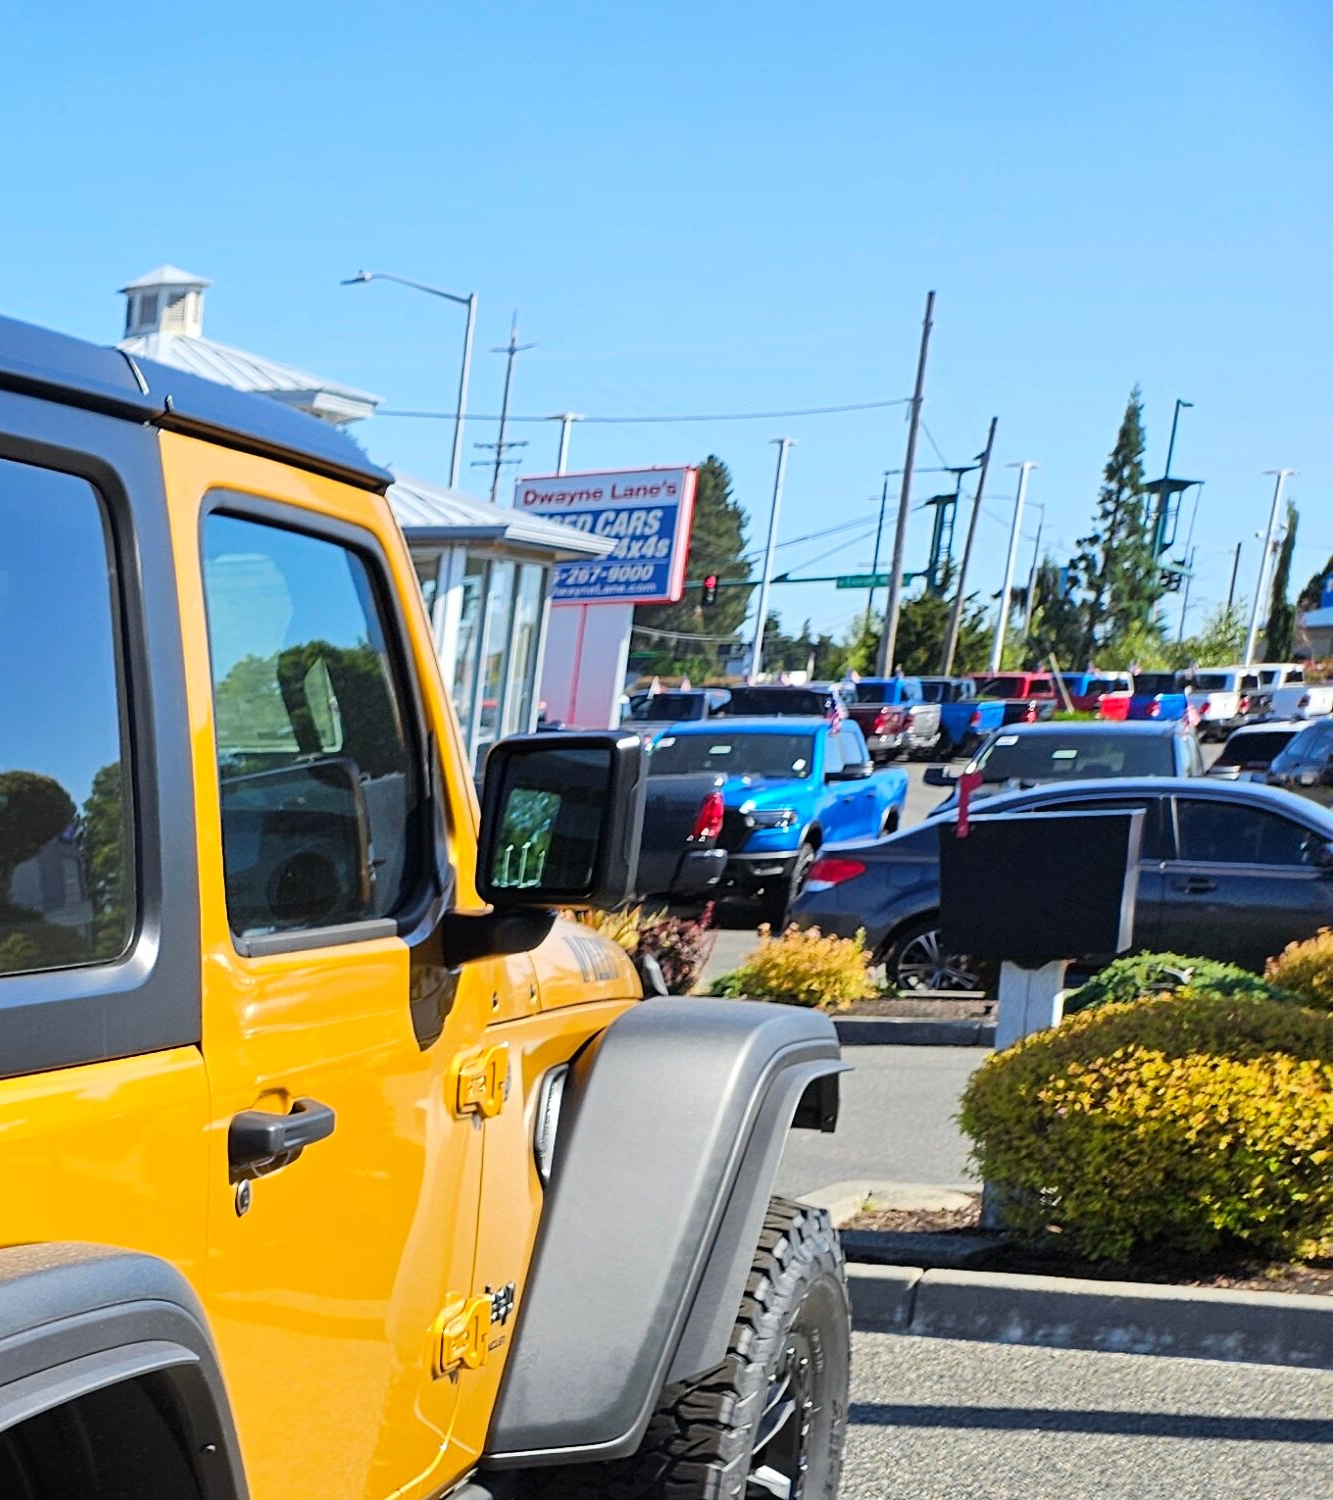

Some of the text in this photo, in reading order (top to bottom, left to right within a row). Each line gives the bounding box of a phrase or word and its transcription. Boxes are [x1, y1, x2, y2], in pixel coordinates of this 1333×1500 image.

[524, 481, 678, 506] Dwayne Lane's
[595, 508, 664, 537] CARS
[611, 534, 671, 560] 4x4s
